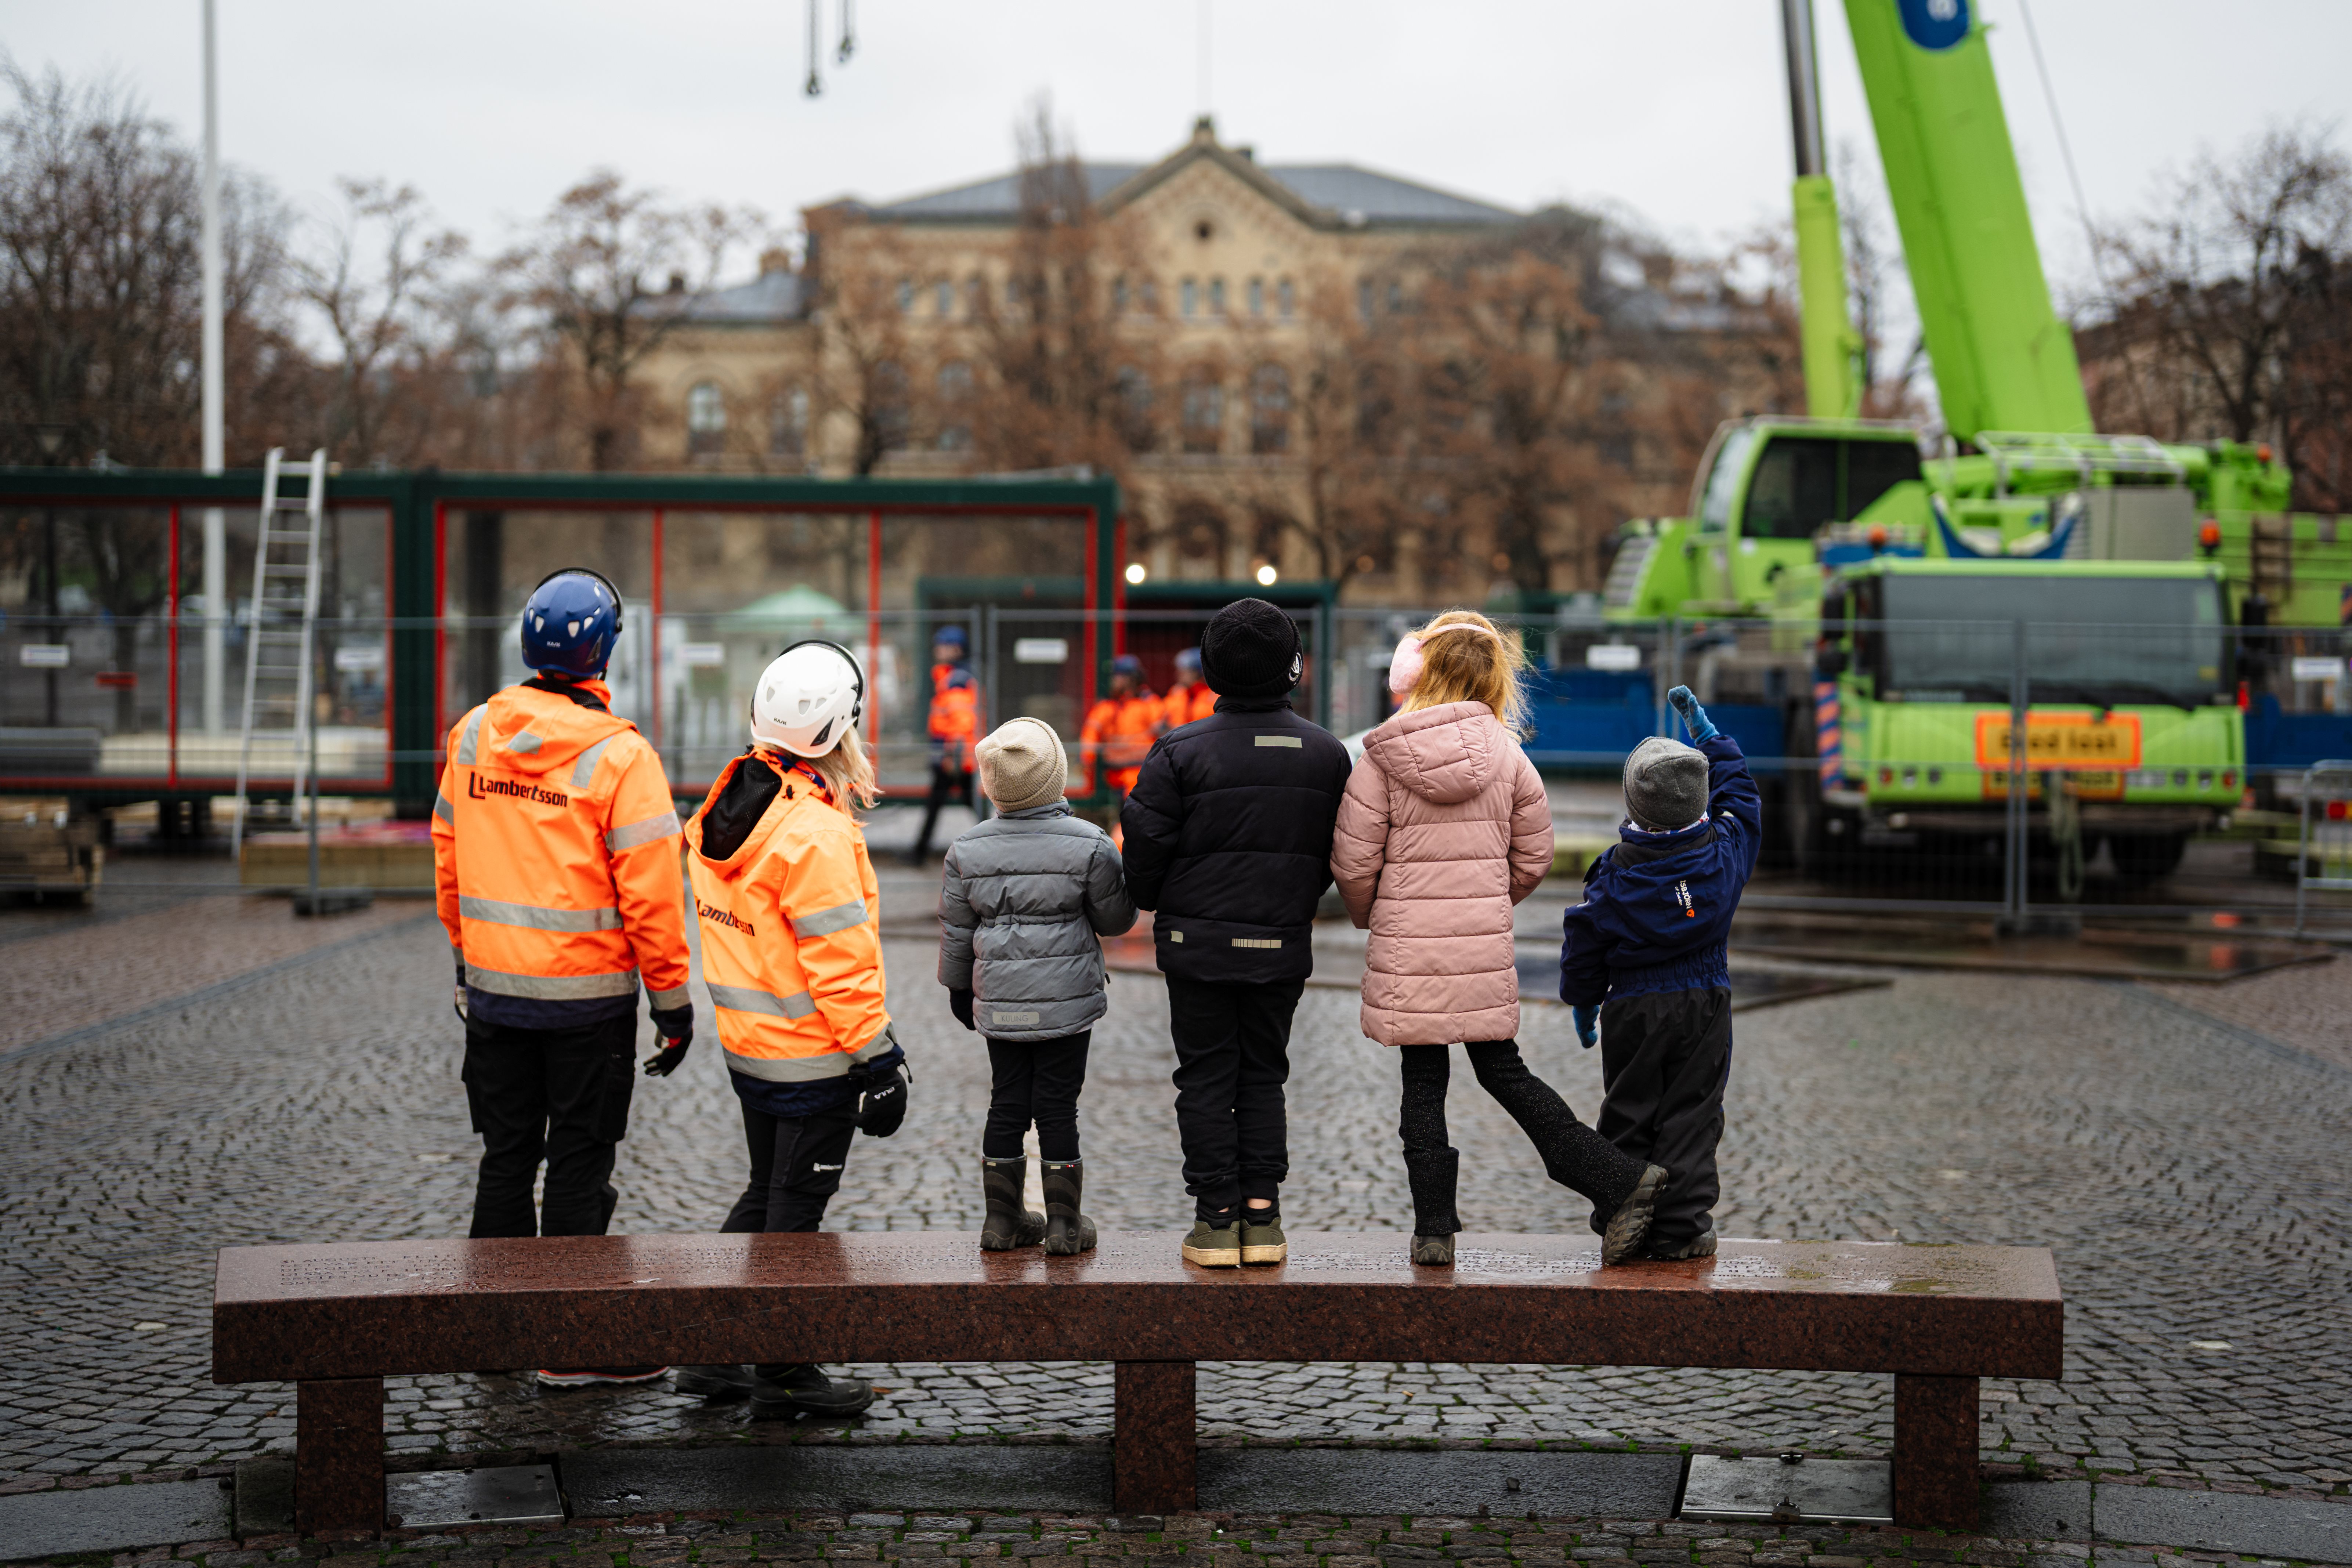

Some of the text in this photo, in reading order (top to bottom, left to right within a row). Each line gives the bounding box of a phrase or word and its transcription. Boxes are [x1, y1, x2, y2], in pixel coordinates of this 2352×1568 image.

[774, 717, 787, 725] KASK
[468, 771, 568, 807] Lambertsson
[1680, 880, 1692, 909] ISBJÖRN
